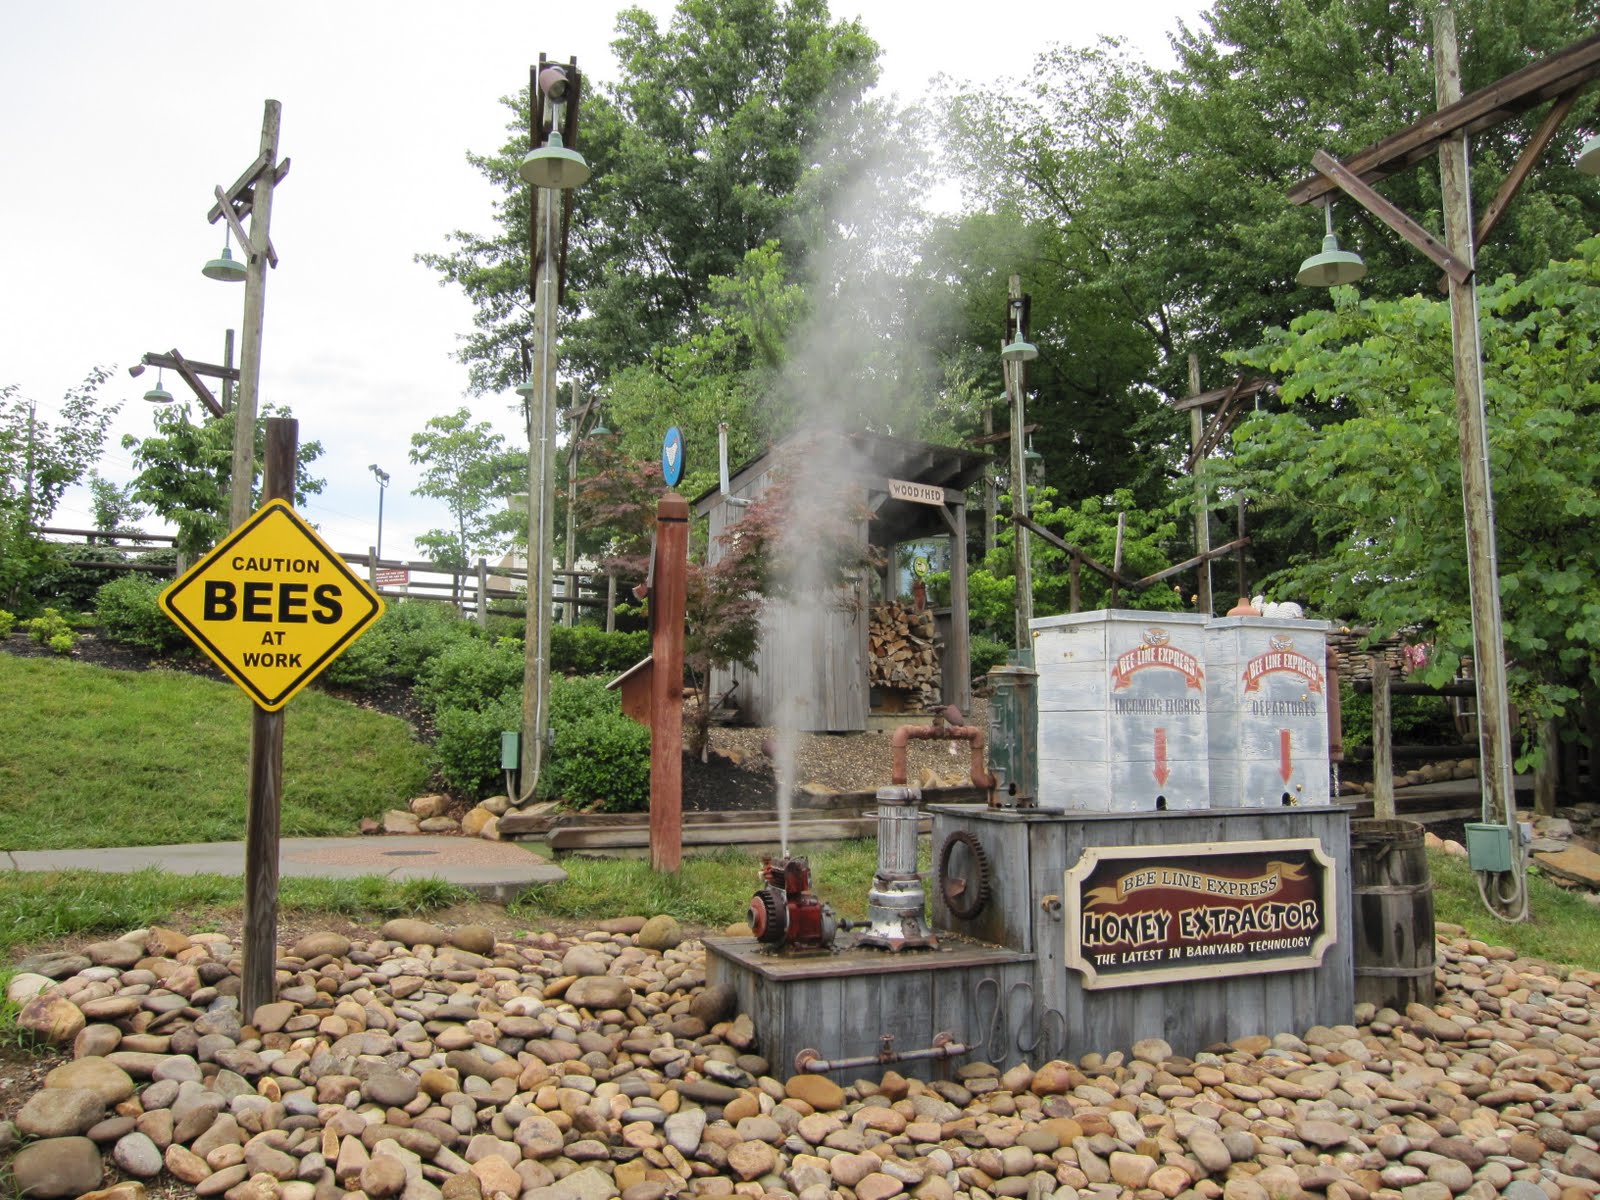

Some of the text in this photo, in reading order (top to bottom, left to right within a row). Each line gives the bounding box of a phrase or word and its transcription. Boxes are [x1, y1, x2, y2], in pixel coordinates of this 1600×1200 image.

[232, 556, 320, 573] CAUTION
[203, 580, 343, 625] BEES
[261, 631, 286, 646] AT
[243, 653, 302, 668] WORK
[1120, 647, 1196, 676] BEE LINE EXPRESS
[1249, 653, 1317, 681] BEE LINE EXPRESS
[1114, 698, 1201, 715] INCOMING FLIGHTS
[1252, 700, 1317, 717] DEPARTURES
[1123, 871, 1278, 896] BEE LINE EXPRESS
[1082, 900, 1319, 947] HONEY EXTRACTOR
[1094, 936, 1311, 966] THE LATEST IN BARNYARD TECHNOLOGY
